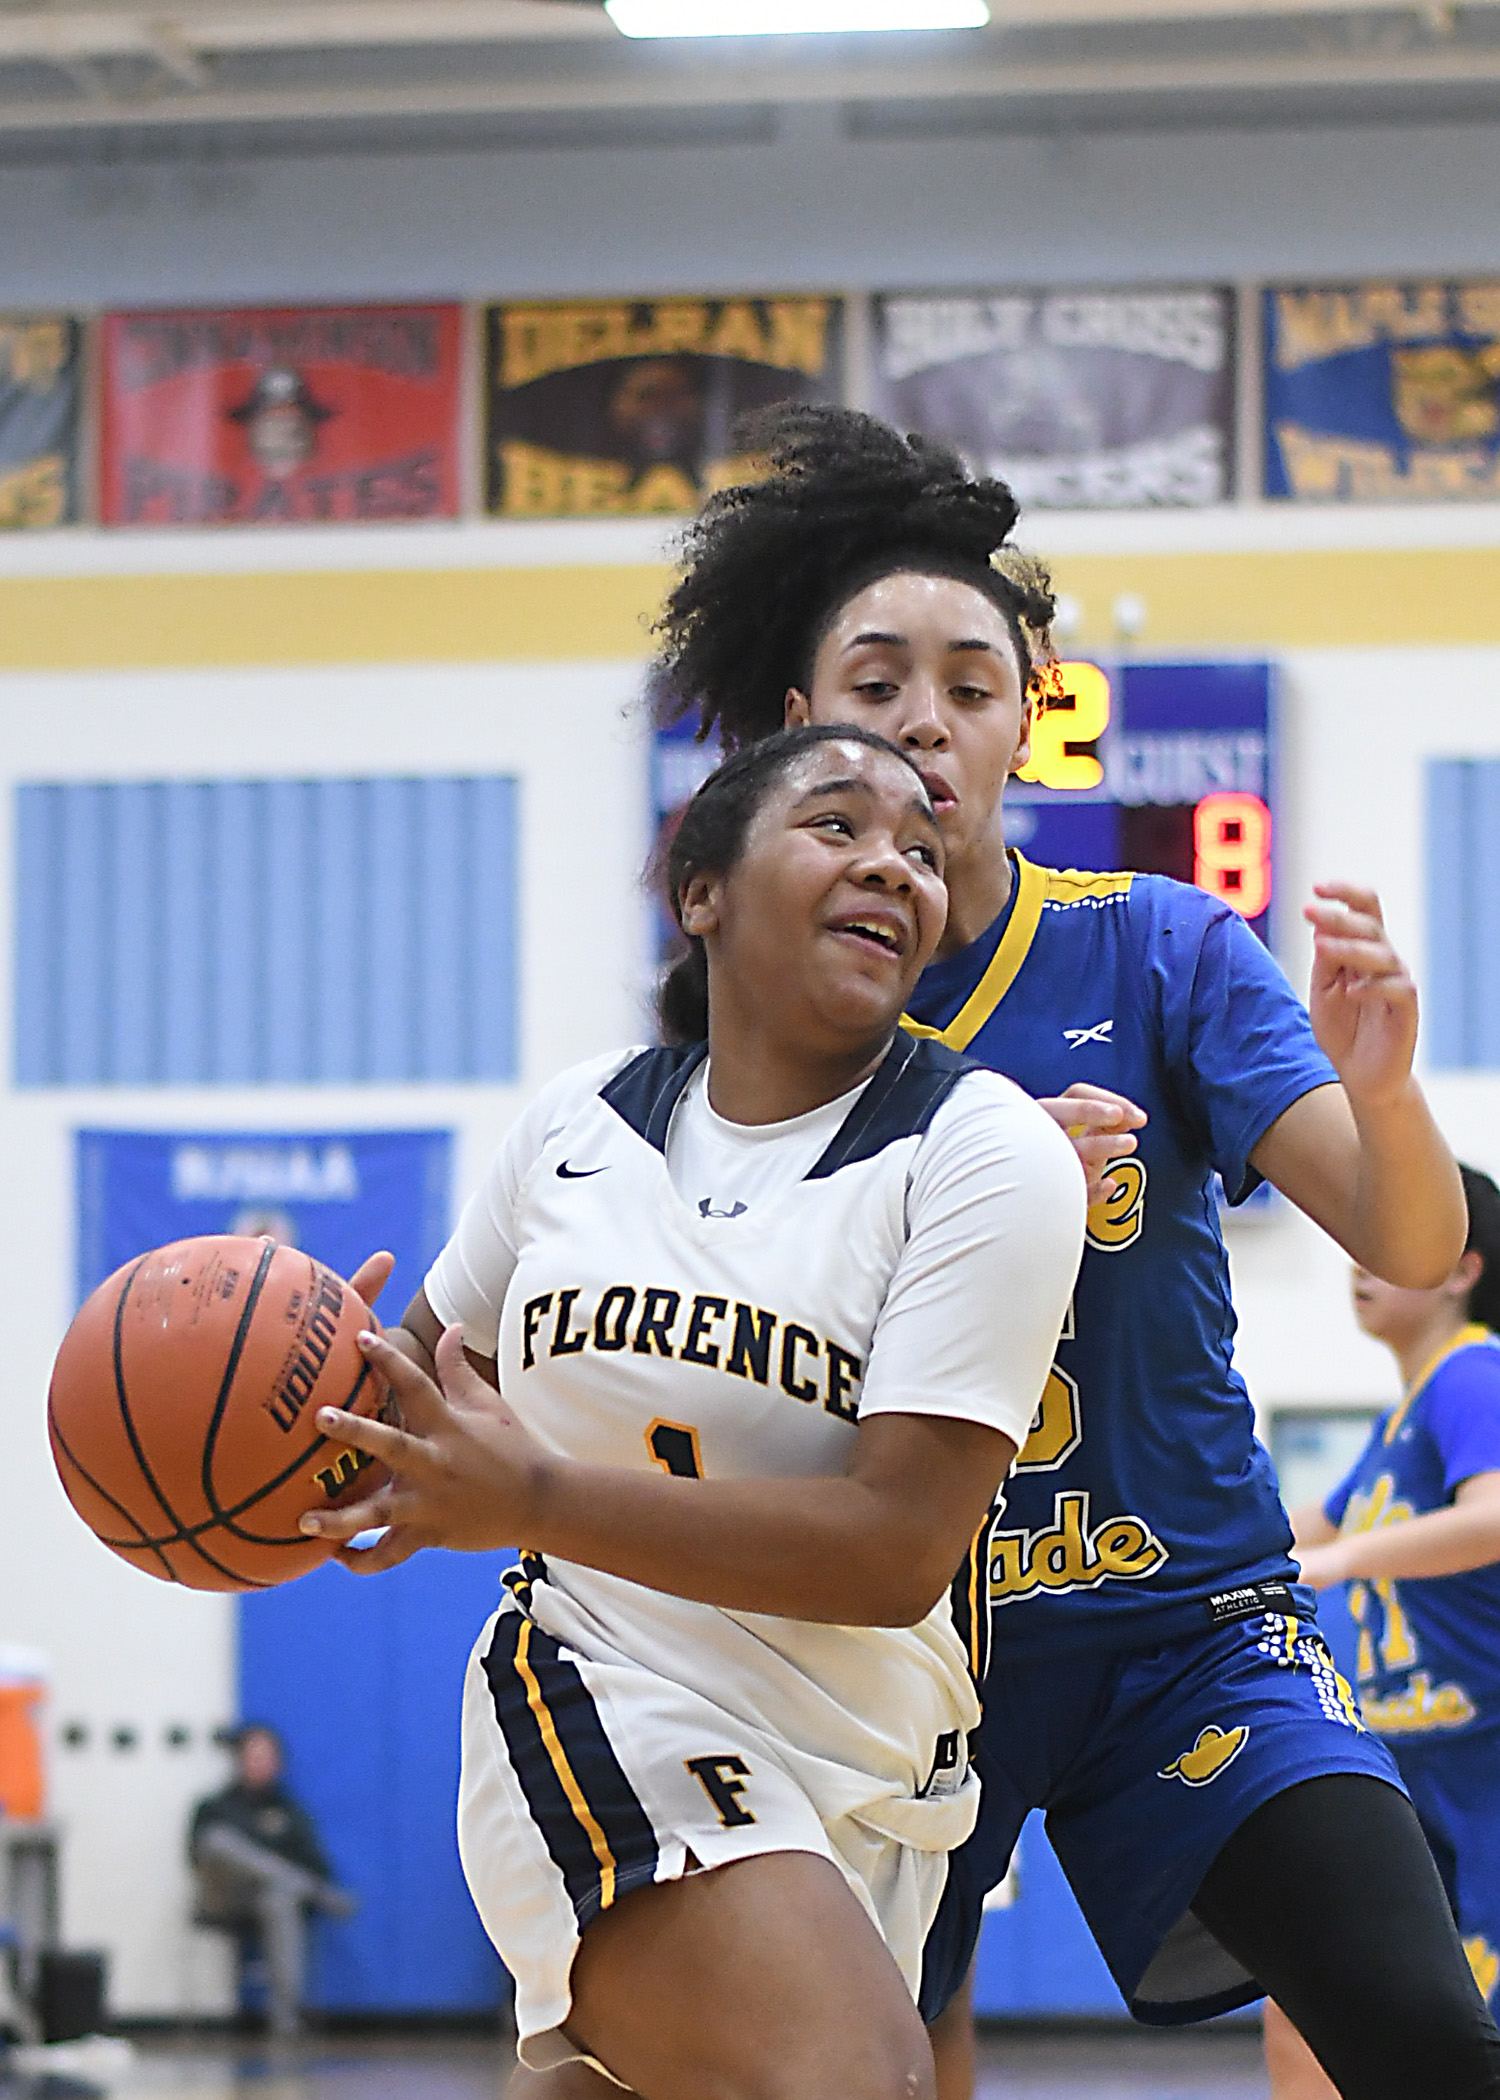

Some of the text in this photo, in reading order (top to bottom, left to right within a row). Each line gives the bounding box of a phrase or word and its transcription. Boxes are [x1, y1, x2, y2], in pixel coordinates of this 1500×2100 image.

[503, 303, 829, 388] DELRAN
[1193, 791, 1272, 918] 8
[521, 1284, 862, 1426] FLORENCE
[989, 1490, 1171, 1606] ade
[1210, 1587, 1257, 1606] MAXIM
[1215, 1597, 1260, 1614] ATHLETIC
[683, 1752, 760, 1831] F
